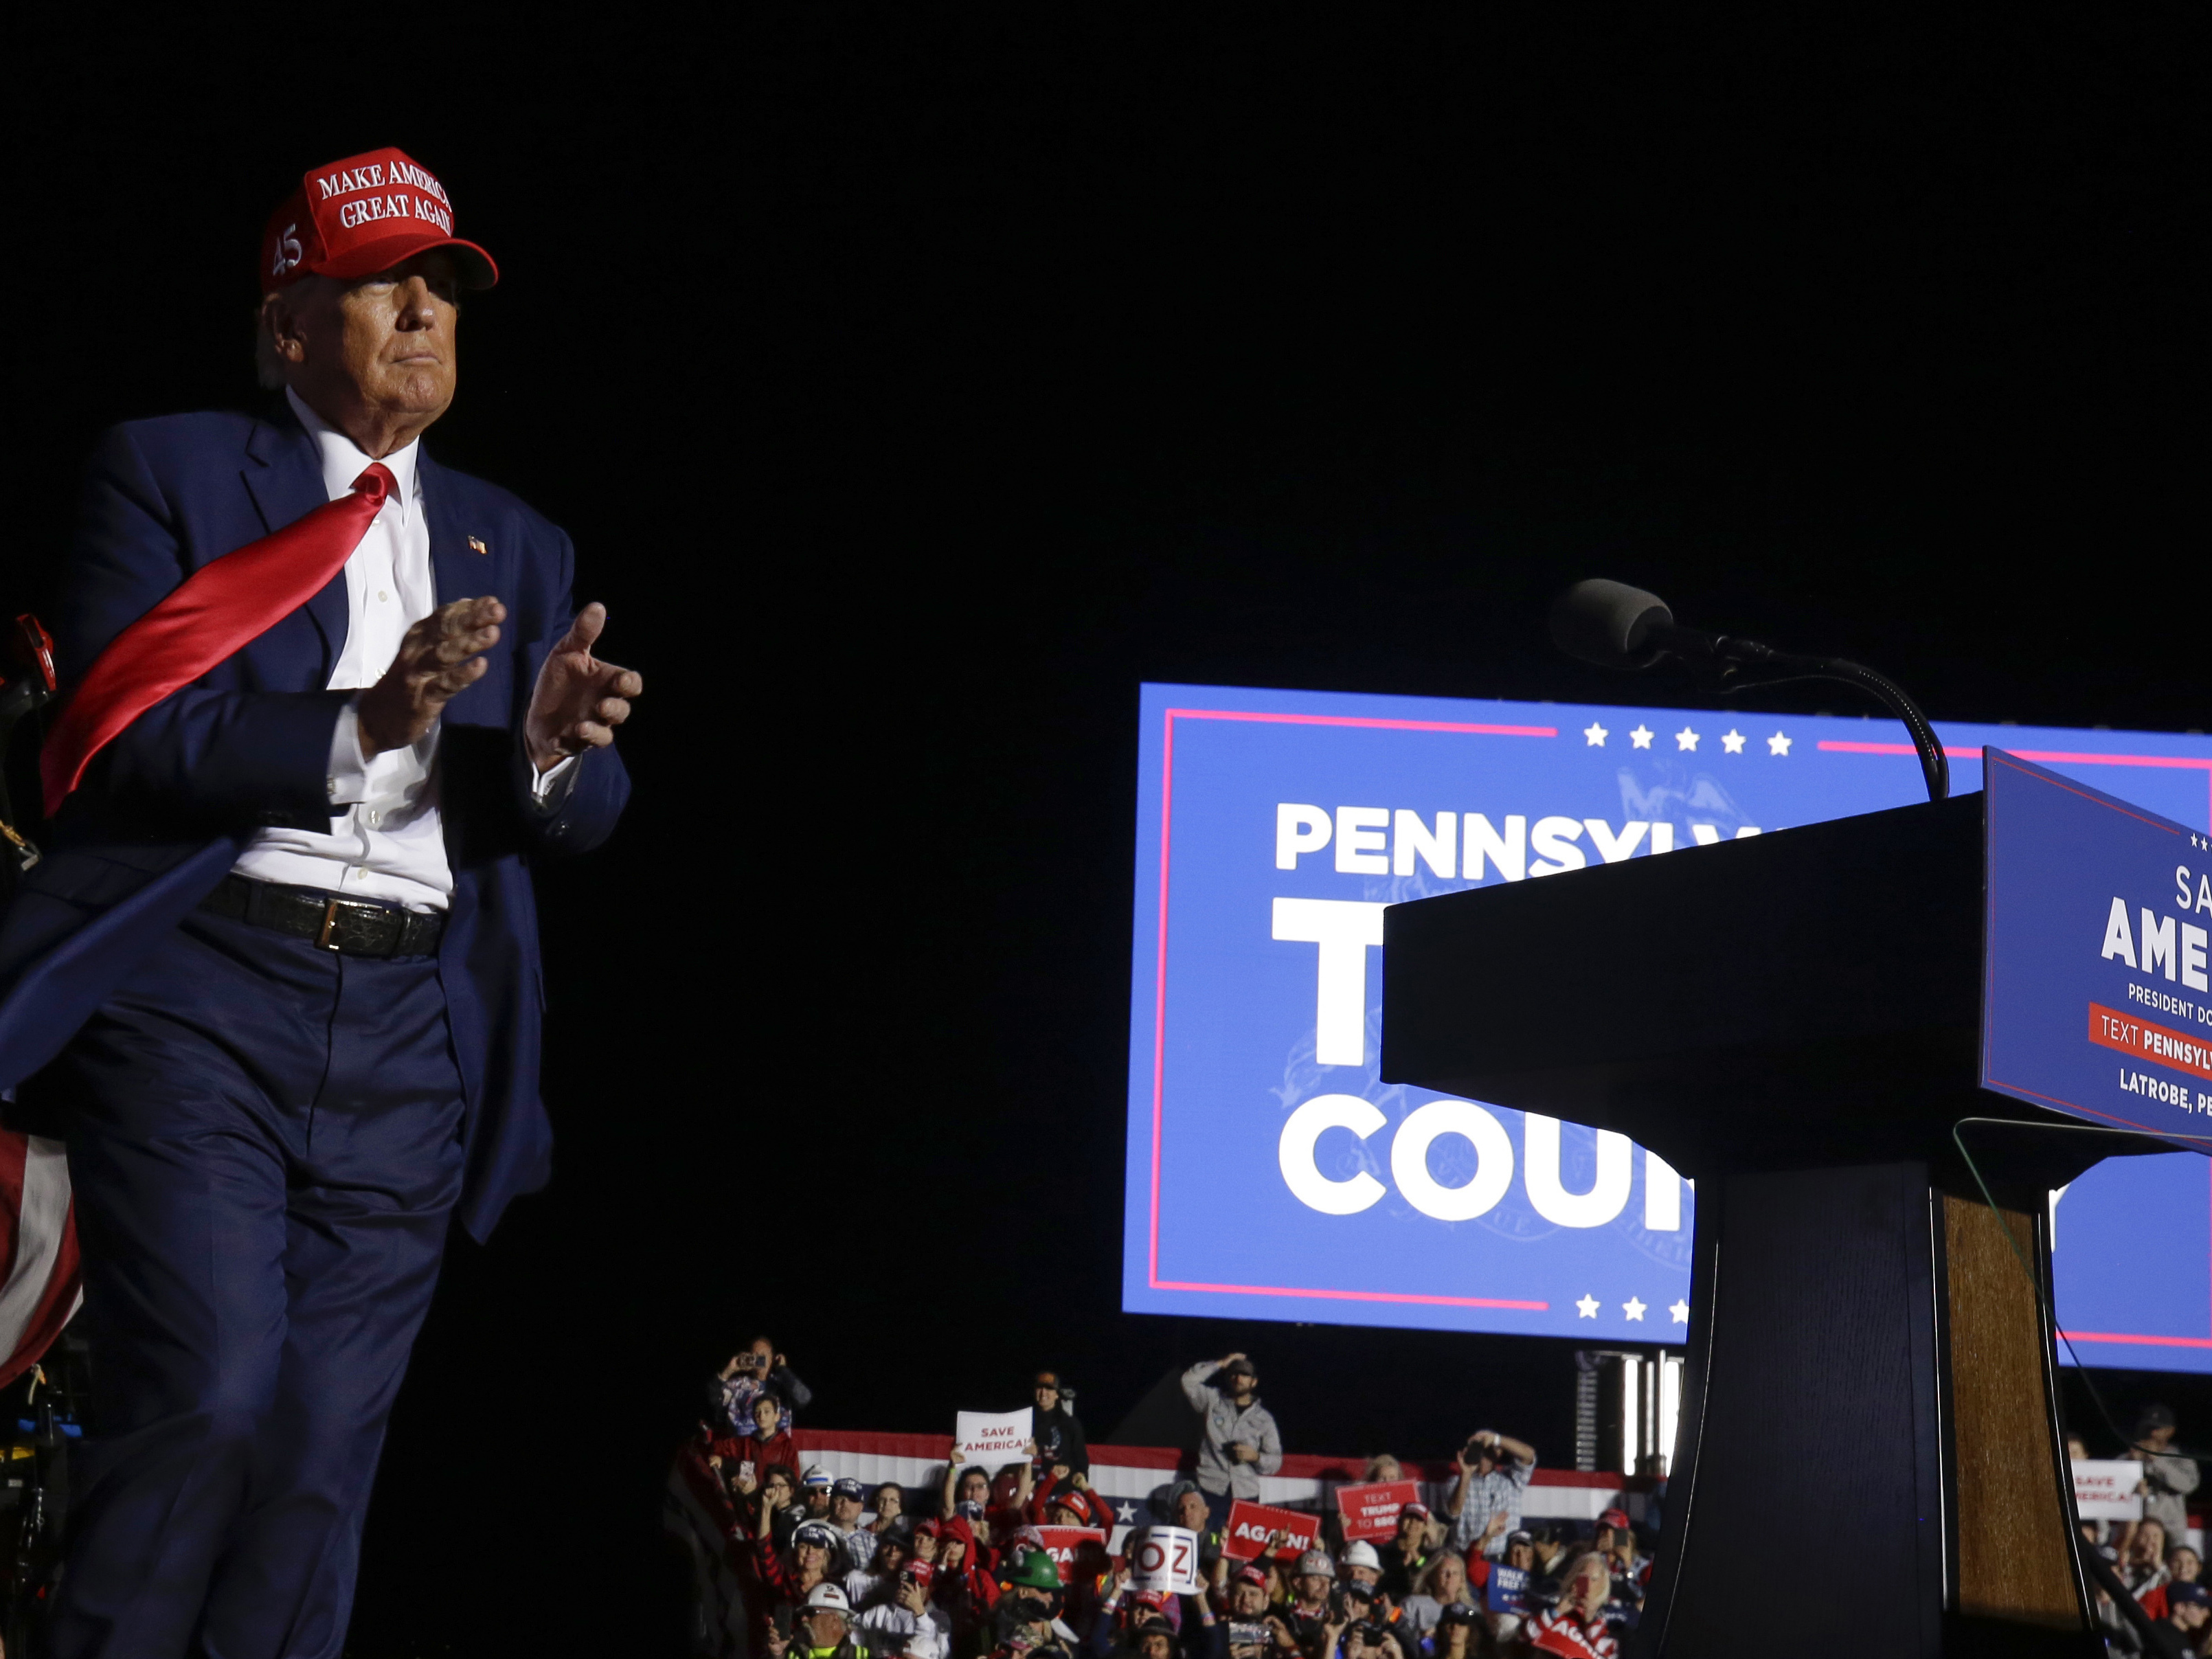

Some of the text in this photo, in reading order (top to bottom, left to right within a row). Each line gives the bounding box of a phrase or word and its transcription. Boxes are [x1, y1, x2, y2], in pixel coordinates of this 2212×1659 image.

[317, 163, 385, 200] MAKE
[340, 194, 410, 229] GREAT
[273, 223, 302, 275] 45
[2101, 896, 2208, 993] AME
[2129, 982, 2193, 1019] PRESIDENT
[2101, 1015, 2212, 1071] TEXT PENNSYL
[2120, 1068, 2193, 1114] LATROBE,
[981, 1426, 1015, 1437] SAVE
[1234, 1522, 1311, 1551] AGN!
[1138, 1542, 1188, 1575] OZ
